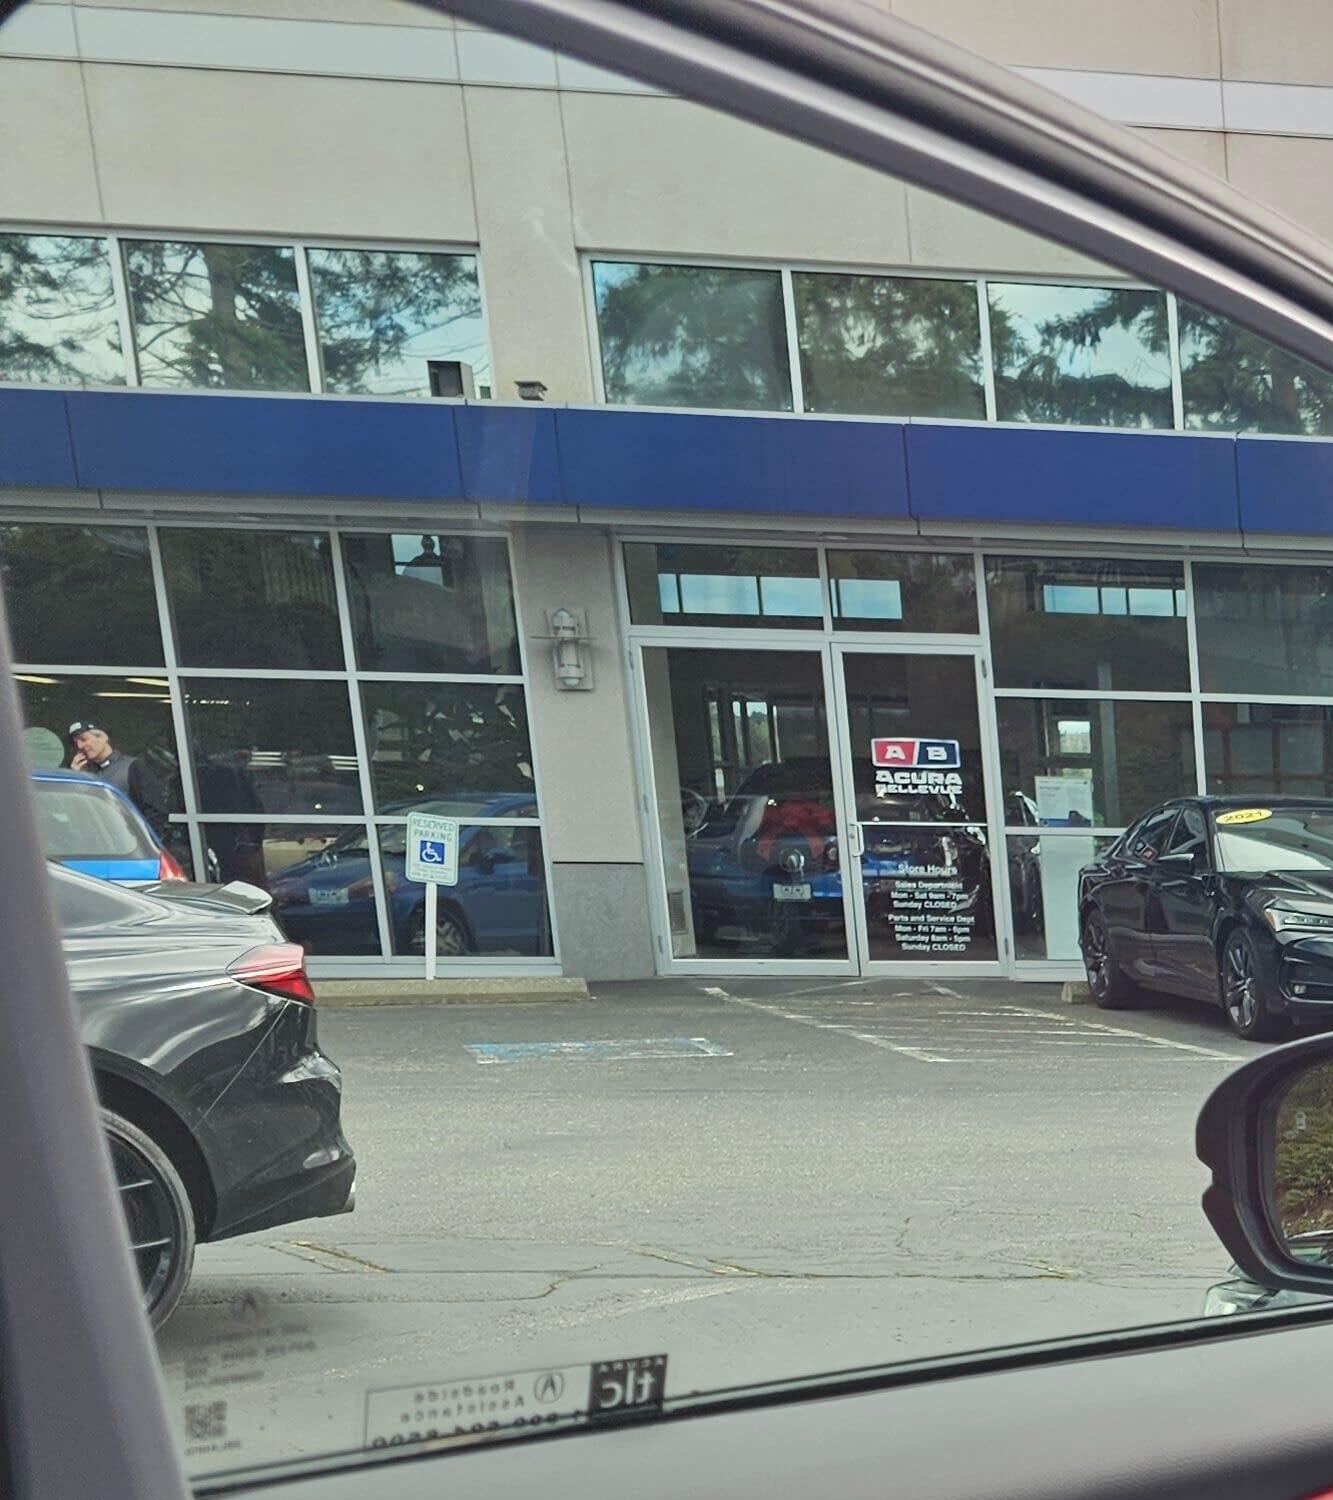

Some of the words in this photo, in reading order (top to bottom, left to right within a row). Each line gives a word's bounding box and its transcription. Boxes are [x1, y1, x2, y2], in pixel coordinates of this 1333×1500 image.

[885, 745, 906, 760] A
[926, 746, 947, 760] B
[876, 770, 962, 785] ACURA
[875, 784, 962, 794] BELLEVUE
[412, 819, 454, 831] RESERVED
[415, 829, 452, 842] PARKING
